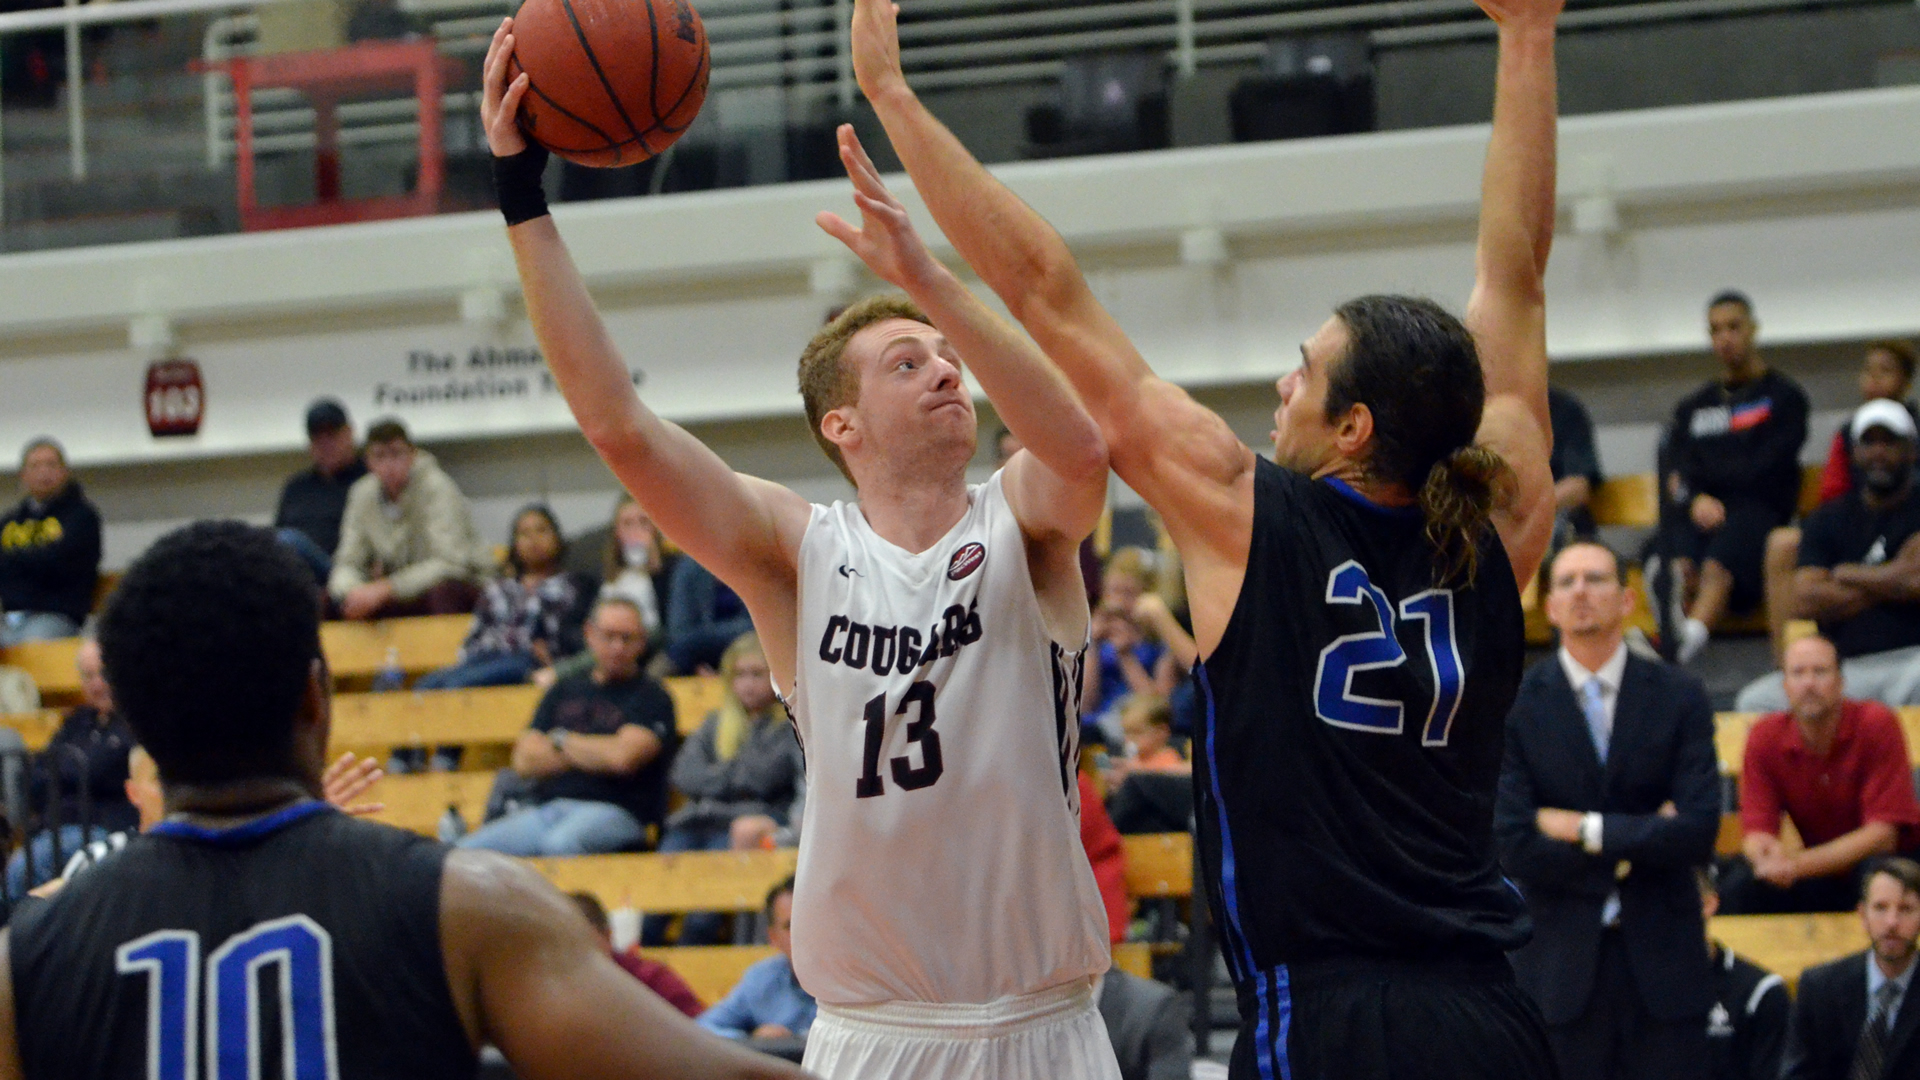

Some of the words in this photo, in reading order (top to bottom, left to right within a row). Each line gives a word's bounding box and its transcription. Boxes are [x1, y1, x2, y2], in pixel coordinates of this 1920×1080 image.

[374, 376, 529, 405] Foundation
[407, 349, 456, 373] The
[461, 345, 545, 369] Ahma
[819, 596, 983, 676] COUGARS
[1313, 559, 1465, 747] 21
[856, 680, 944, 799] 13
[115, 912, 341, 1080] 10
